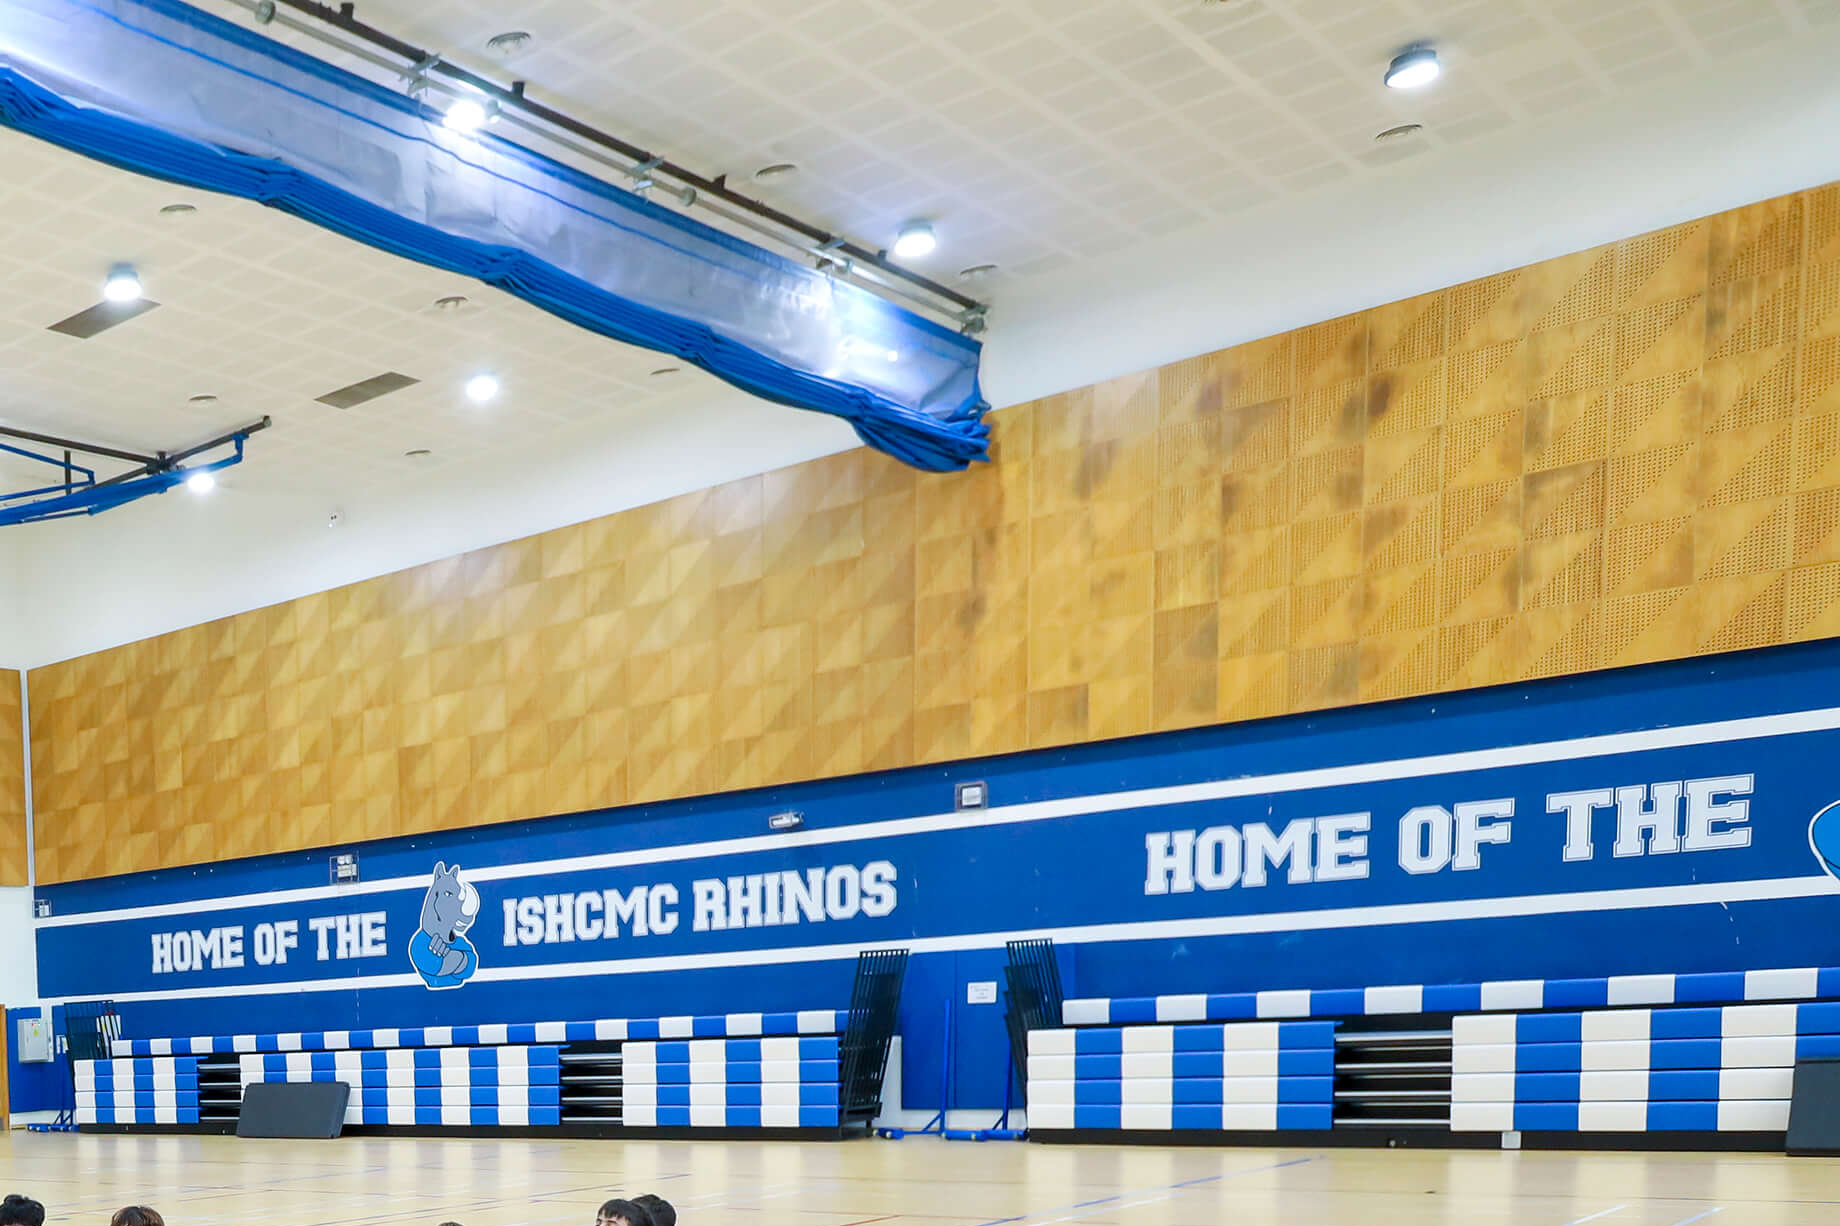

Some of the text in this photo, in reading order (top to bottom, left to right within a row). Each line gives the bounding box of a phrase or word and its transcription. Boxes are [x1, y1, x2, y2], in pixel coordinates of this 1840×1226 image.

[1145, 773, 1755, 896] HOME OF THE
[151, 859, 898, 974] HOME OF THE ISHCMC RHINOS
